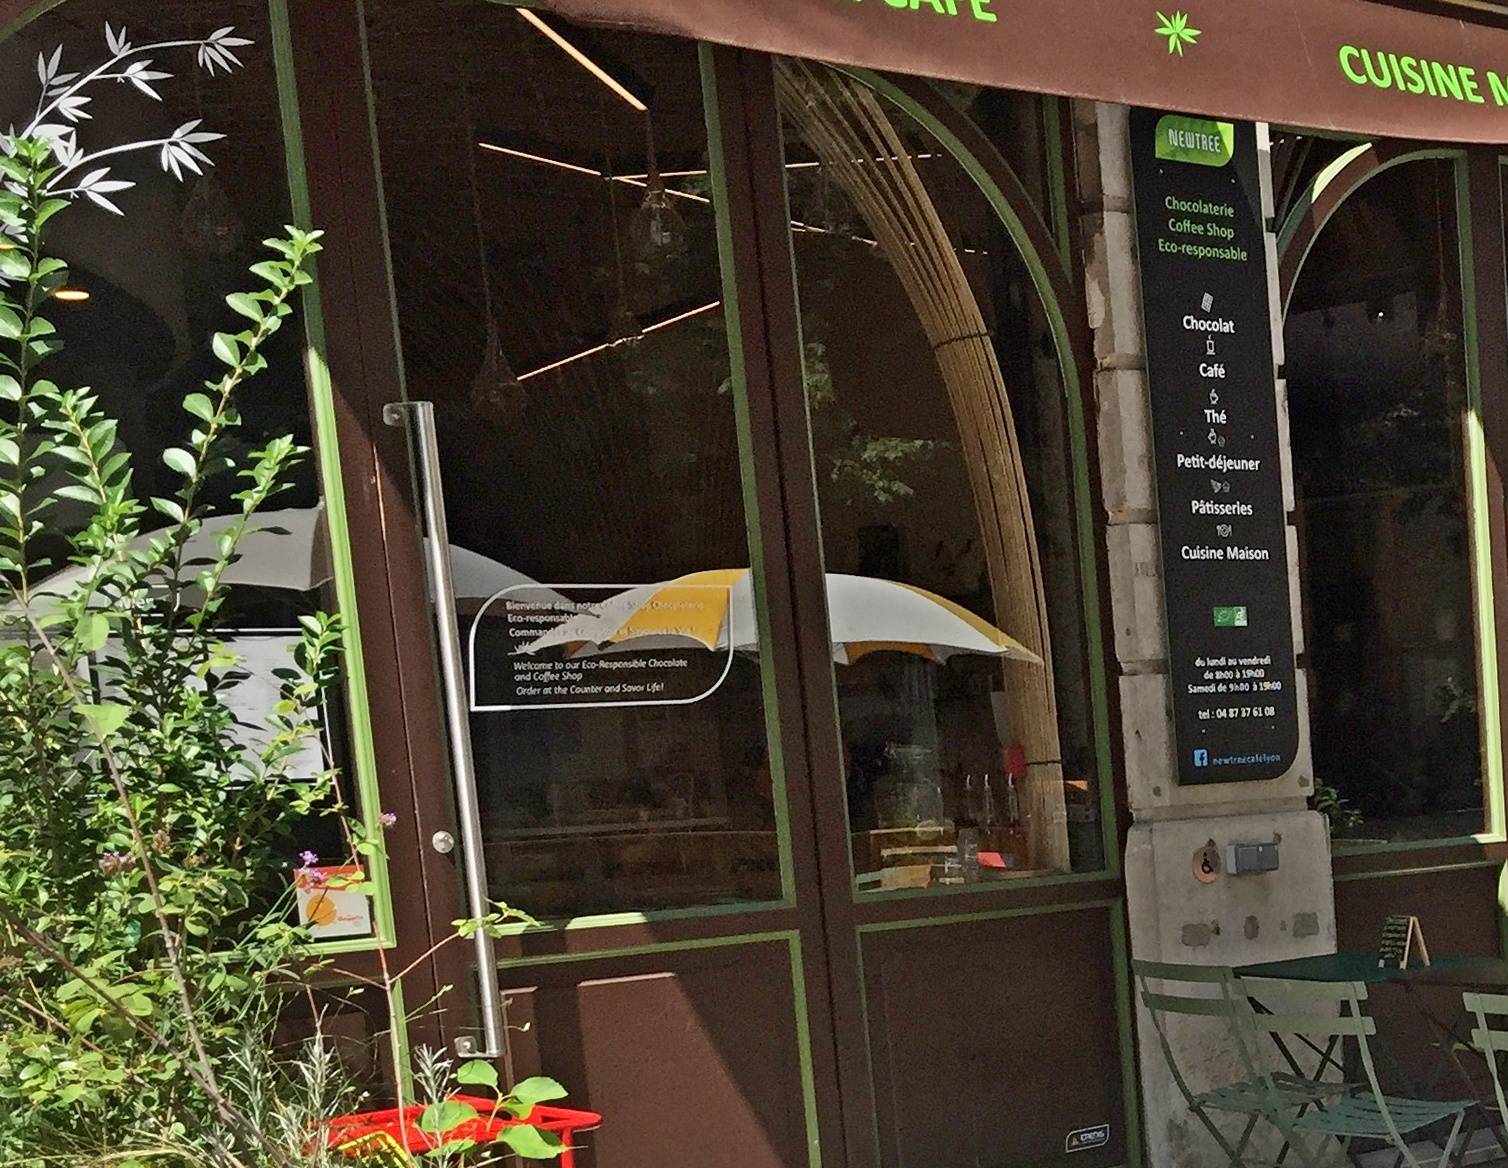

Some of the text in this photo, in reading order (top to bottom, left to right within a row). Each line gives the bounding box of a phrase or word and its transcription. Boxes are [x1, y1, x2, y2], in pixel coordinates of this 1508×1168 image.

[1338, 45, 1485, 104] CUISINE
[1168, 128, 1221, 153] NEWTREE
[1165, 196, 1234, 218] Chocolaterie
[1168, 218, 1235, 241] Coffee Shop
[1158, 239, 1248, 261] Eco-responsable
[1183, 315, 1235, 333] Chocolat
[1199, 362, 1226, 379] Café
[1204, 409, 1227, 424] Thé
[1177, 453, 1260, 473] Petit-déjeuner
[1191, 500, 1253, 516] Pâtisseries
[1181, 546, 1269, 561] Cuisine Maison
[506, 601, 553, 610] Bienvenue
[507, 613, 576, 624] Eco-responsabl
[513, 658, 688, 670] Welcome to our Eco-Responsible Chocolate
[1239, 655, 1271, 665] vendredi
[514, 671, 583, 682] and Coffee Shop
[516, 686, 541, 696] Order
[543, 686, 552, 695] at
[553, 685, 568, 694] the
[569, 685, 601, 695] Counter
[604, 684, 620, 693] and
[622, 683, 645, 692] Savor
[1188, 683, 1216, 693] Samedi
[1217, 683, 1227, 692] de
[1216, 708, 1227, 718] 04
[1228, 707, 1239, 718] 87
[1252, 706, 1263, 717] 61
[1264, 706, 1275, 717] 08
